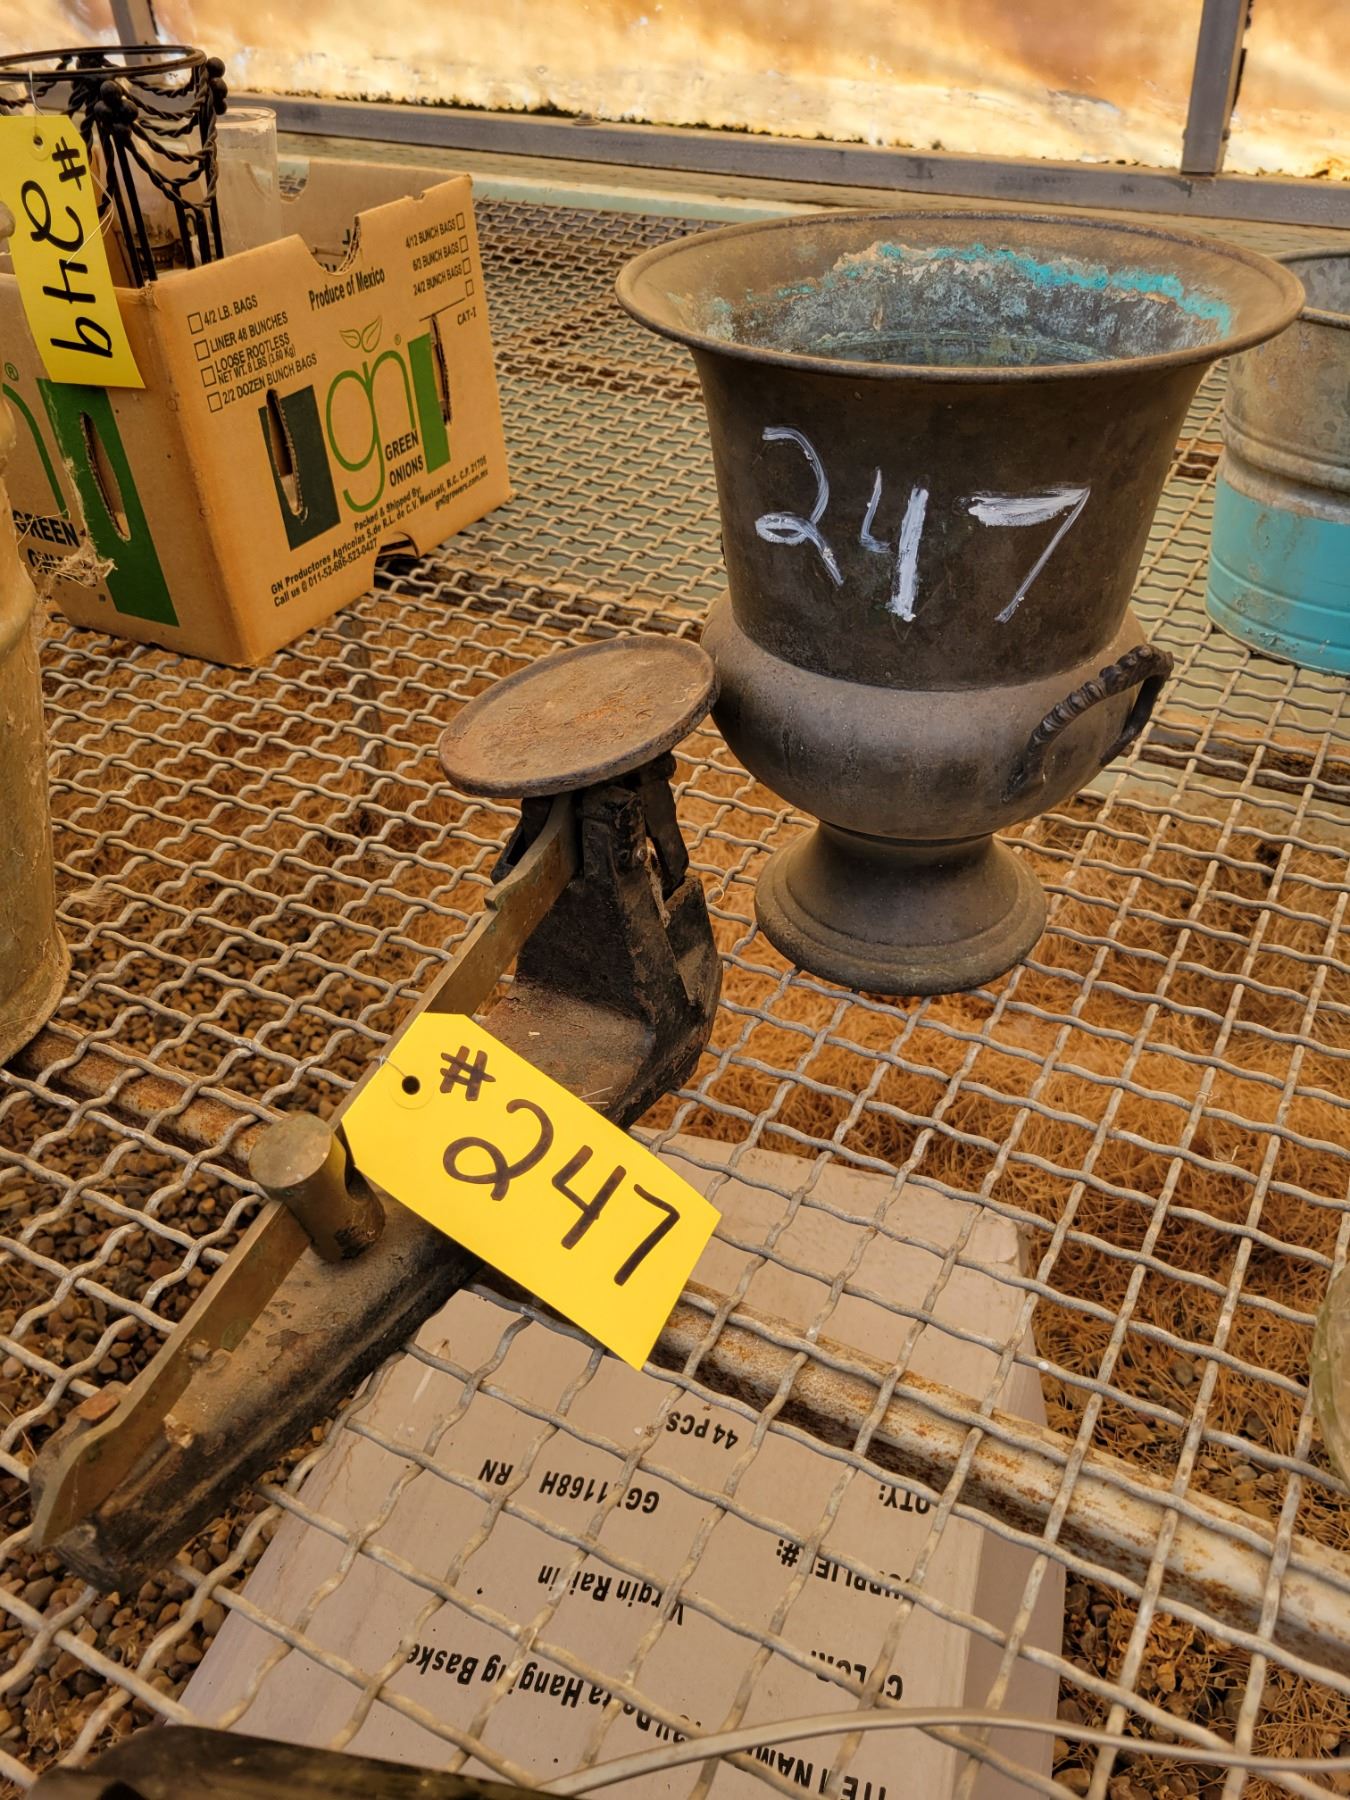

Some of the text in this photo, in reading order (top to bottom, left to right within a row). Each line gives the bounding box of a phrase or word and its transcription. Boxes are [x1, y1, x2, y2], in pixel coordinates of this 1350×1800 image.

[21, 136, 113, 358] #249
[418, 226, 440, 246] BUNCH
[440, 219, 456, 238] BAGS
[422, 248, 443, 269] BUNCH
[443, 241, 460, 260] BAGS
[308, 266, 386, 311] Produce of Mexico
[426, 272, 447, 292] BUNCH
[446, 264, 463, 282] BAGS
[204, 294, 258, 326] 4/2 LB. BAGS
[210, 311, 288, 353] LINER 48 BUNCHES
[215, 332, 290, 373] LOOSE ROOTLESS
[218, 370, 233, 386] NET
[234, 364, 247, 380] WT.
[247, 361, 253, 374] 8
[253, 355, 268, 371] LBS
[222, 353, 318, 405] 2/2 DOZEN BUNCH BAGS
[384, 430, 419, 462] GREEN
[389, 454, 424, 487] ONIONS
[12, 509, 81, 548] GREEN
[354, 511, 378, 532] Packed
[386, 493, 411, 514] Shipped
[754, 426, 1092, 624] 247
[271, 581, 284, 594] GN
[284, 555, 331, 587] Productores
[274, 591, 290, 607] Call
[291, 587, 301, 598] us
[440, 1045, 681, 1287] #247
[666, 1411, 738, 1450] 44 PCS
[477, 1459, 661, 1514] GG1168H RN
[537, 1566, 684, 1627] Vrgin Raiin
[393, 1640, 479, 1686] Baske
